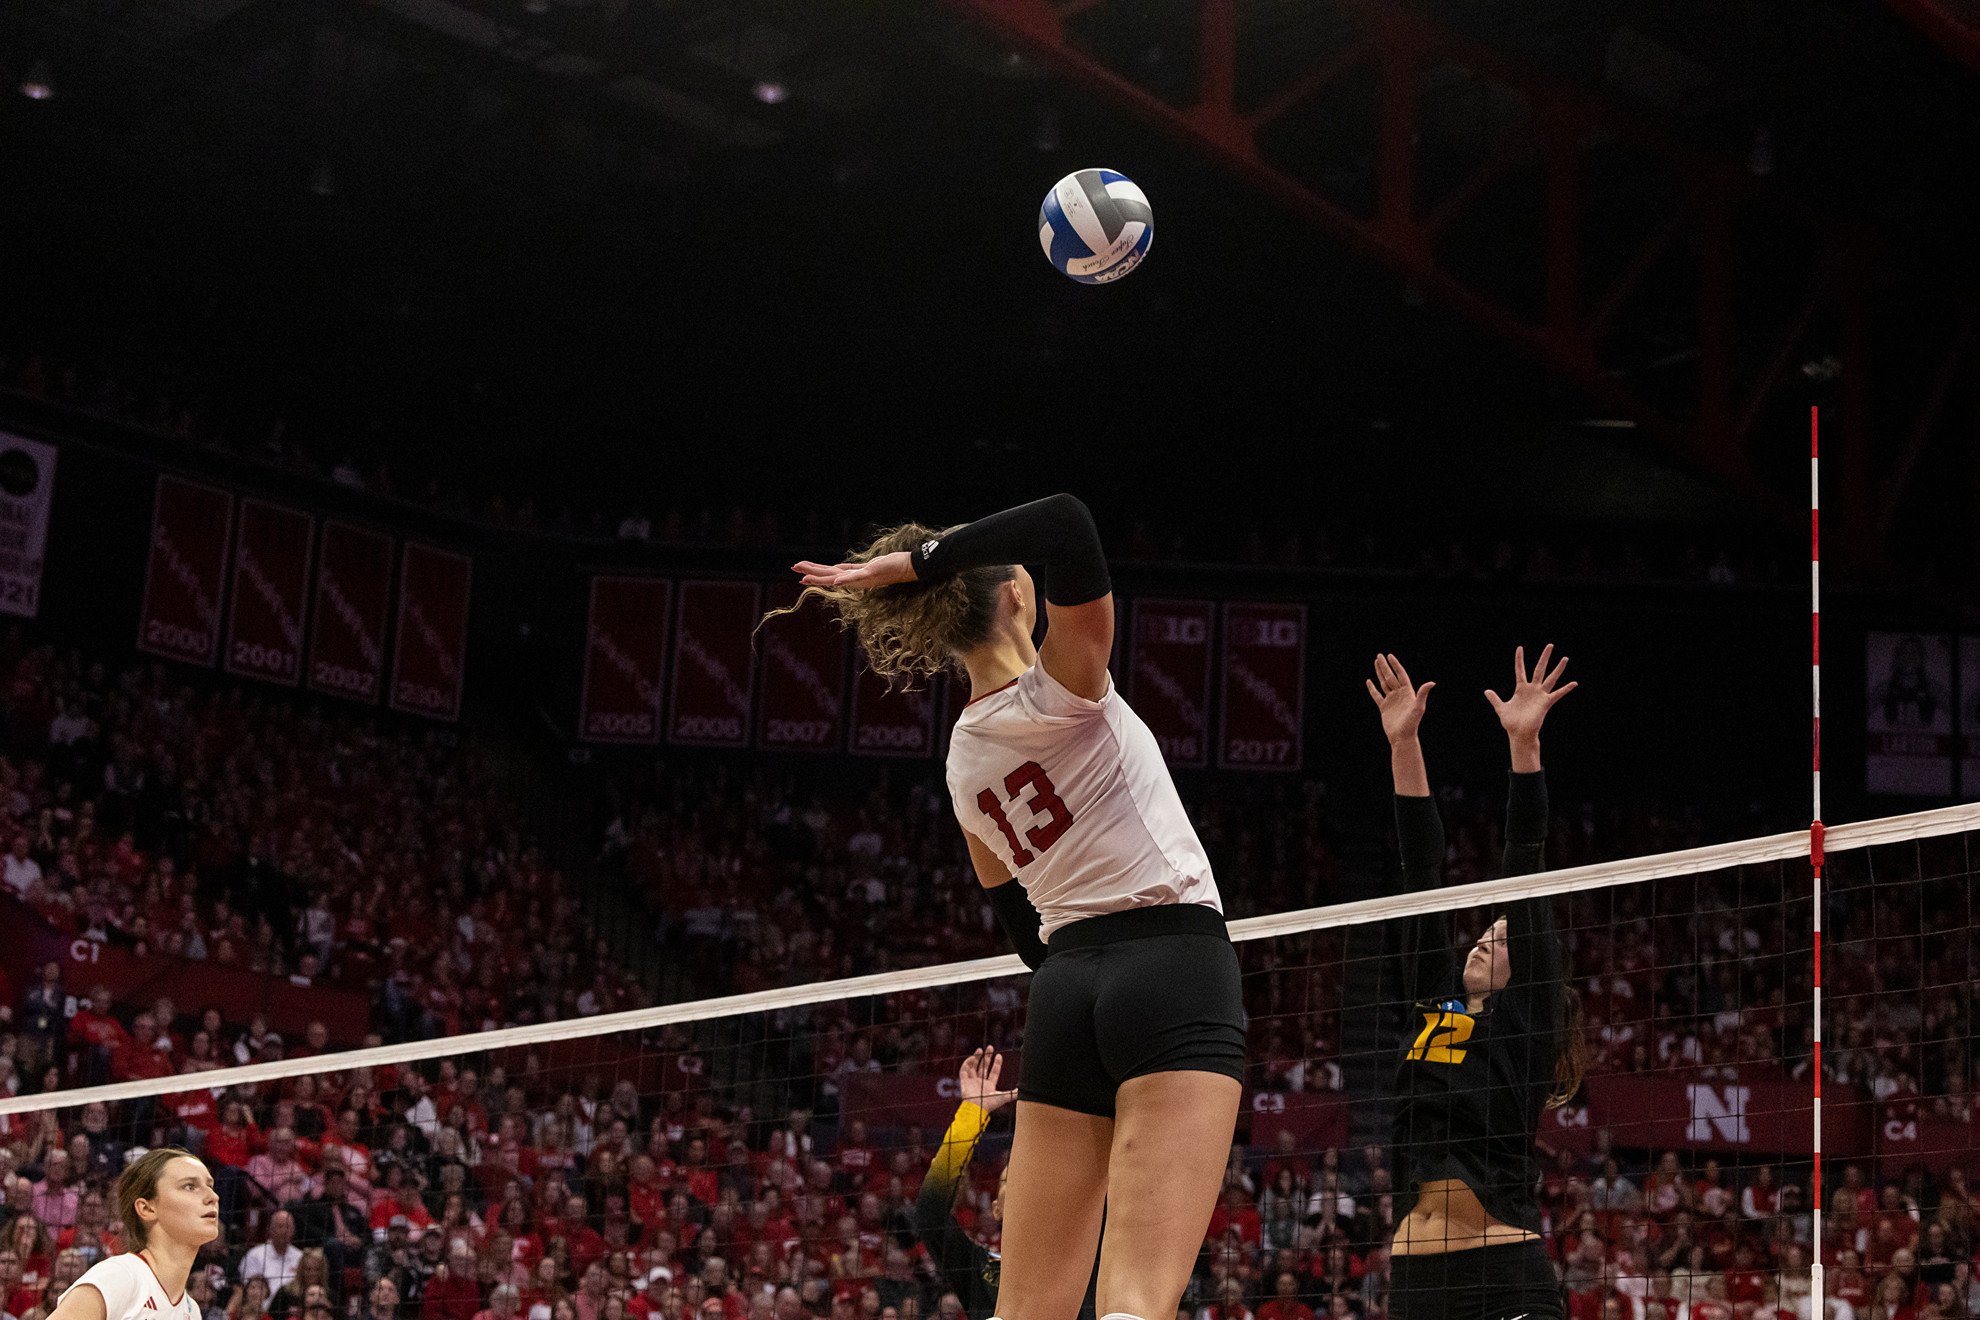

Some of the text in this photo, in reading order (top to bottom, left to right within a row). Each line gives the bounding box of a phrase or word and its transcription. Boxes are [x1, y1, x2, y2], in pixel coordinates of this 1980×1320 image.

[1082, 234, 1134, 273] Super Touch
[0, 577, 36, 606] 21
[233, 641, 295, 675] 2001
[767, 720, 832, 743] 2007
[1229, 739, 1292, 762] 2017
[976, 760, 1074, 869] 13
[1405, 1012, 1476, 1064] 12
[1686, 1083, 1750, 1143] N
[1884, 1120, 1917, 1141] C4
